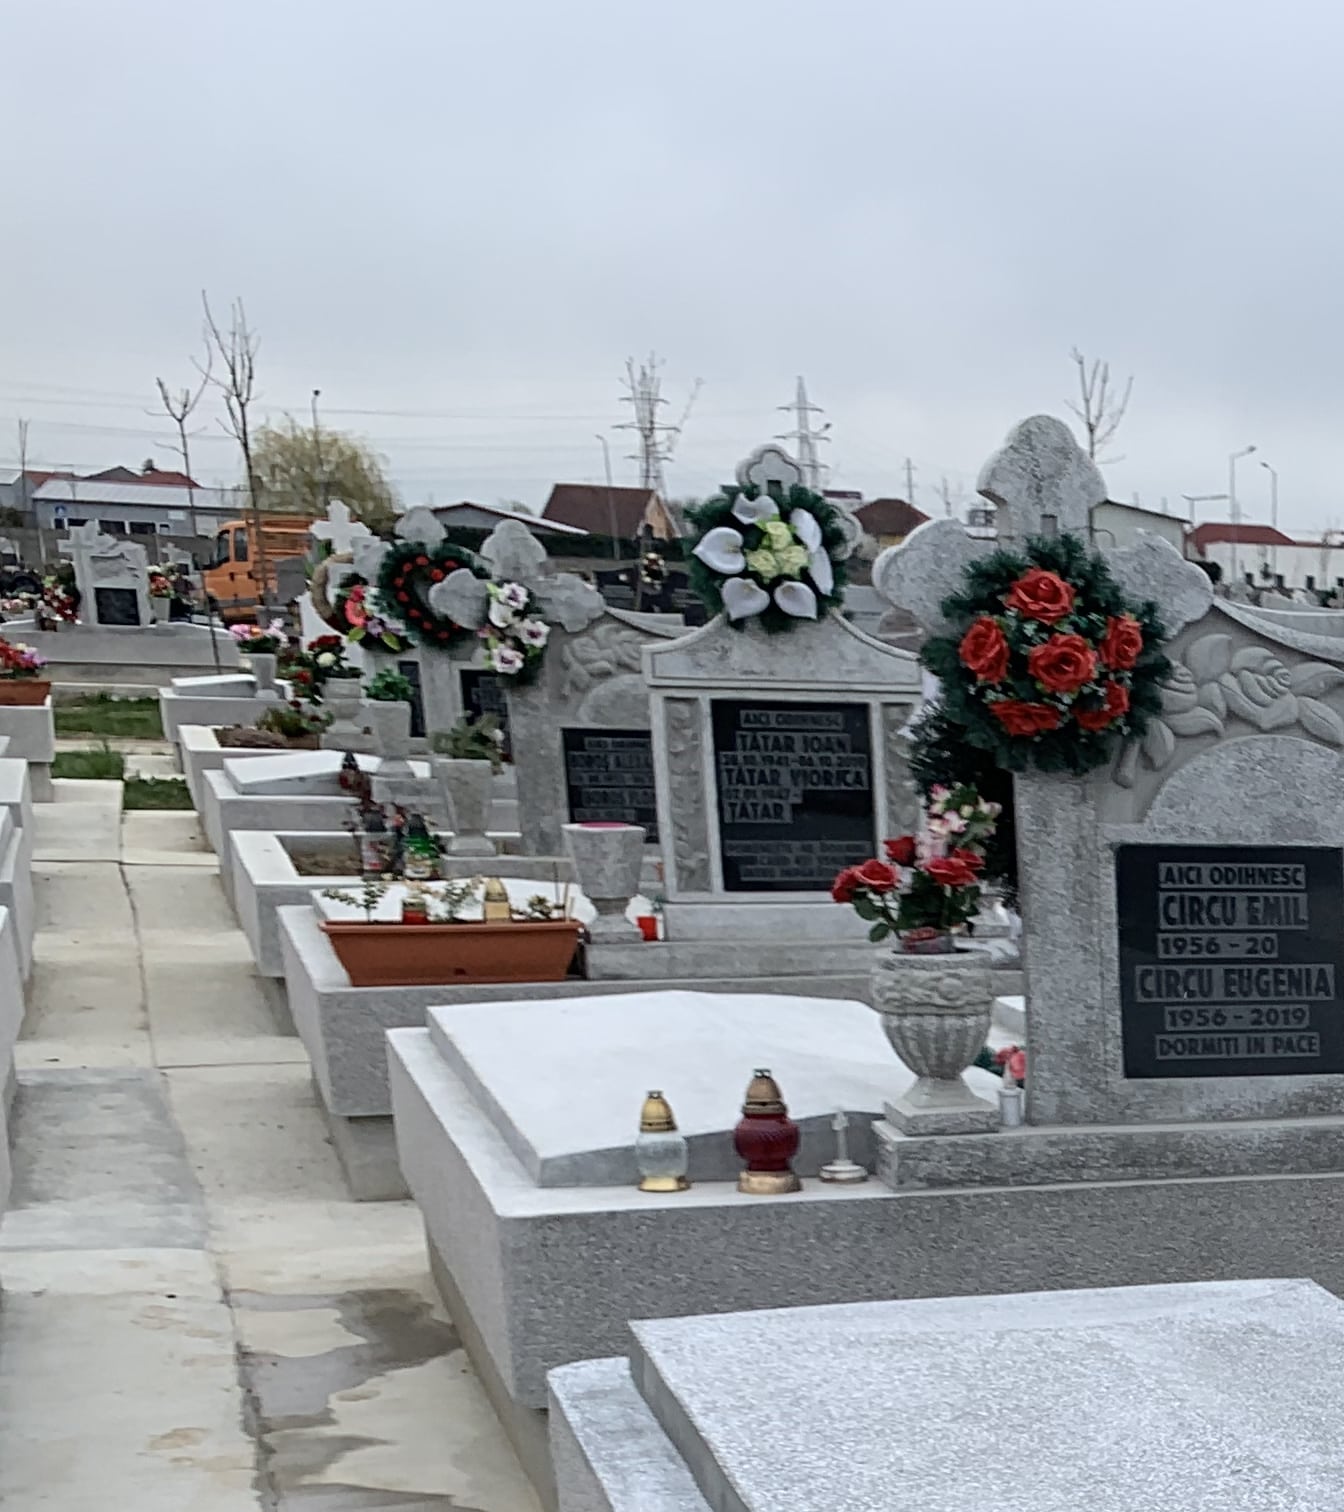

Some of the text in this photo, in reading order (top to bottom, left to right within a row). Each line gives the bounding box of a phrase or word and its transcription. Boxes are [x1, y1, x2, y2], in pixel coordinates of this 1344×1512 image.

[1163, 866, 1303, 885] AICI ODIHNESC
[1162, 895, 1307, 926] CIRCU EMIL
[1161, 937, 1220, 954] 1956
[1246, 937, 1275, 954] 20
[1139, 967, 1332, 999] CIRCU EUGENIA
[1169, 1009, 1227, 1027] 1956
[1251, 1008, 1306, 1025] 2019
[1274, 1035, 1317, 1053] PACE
